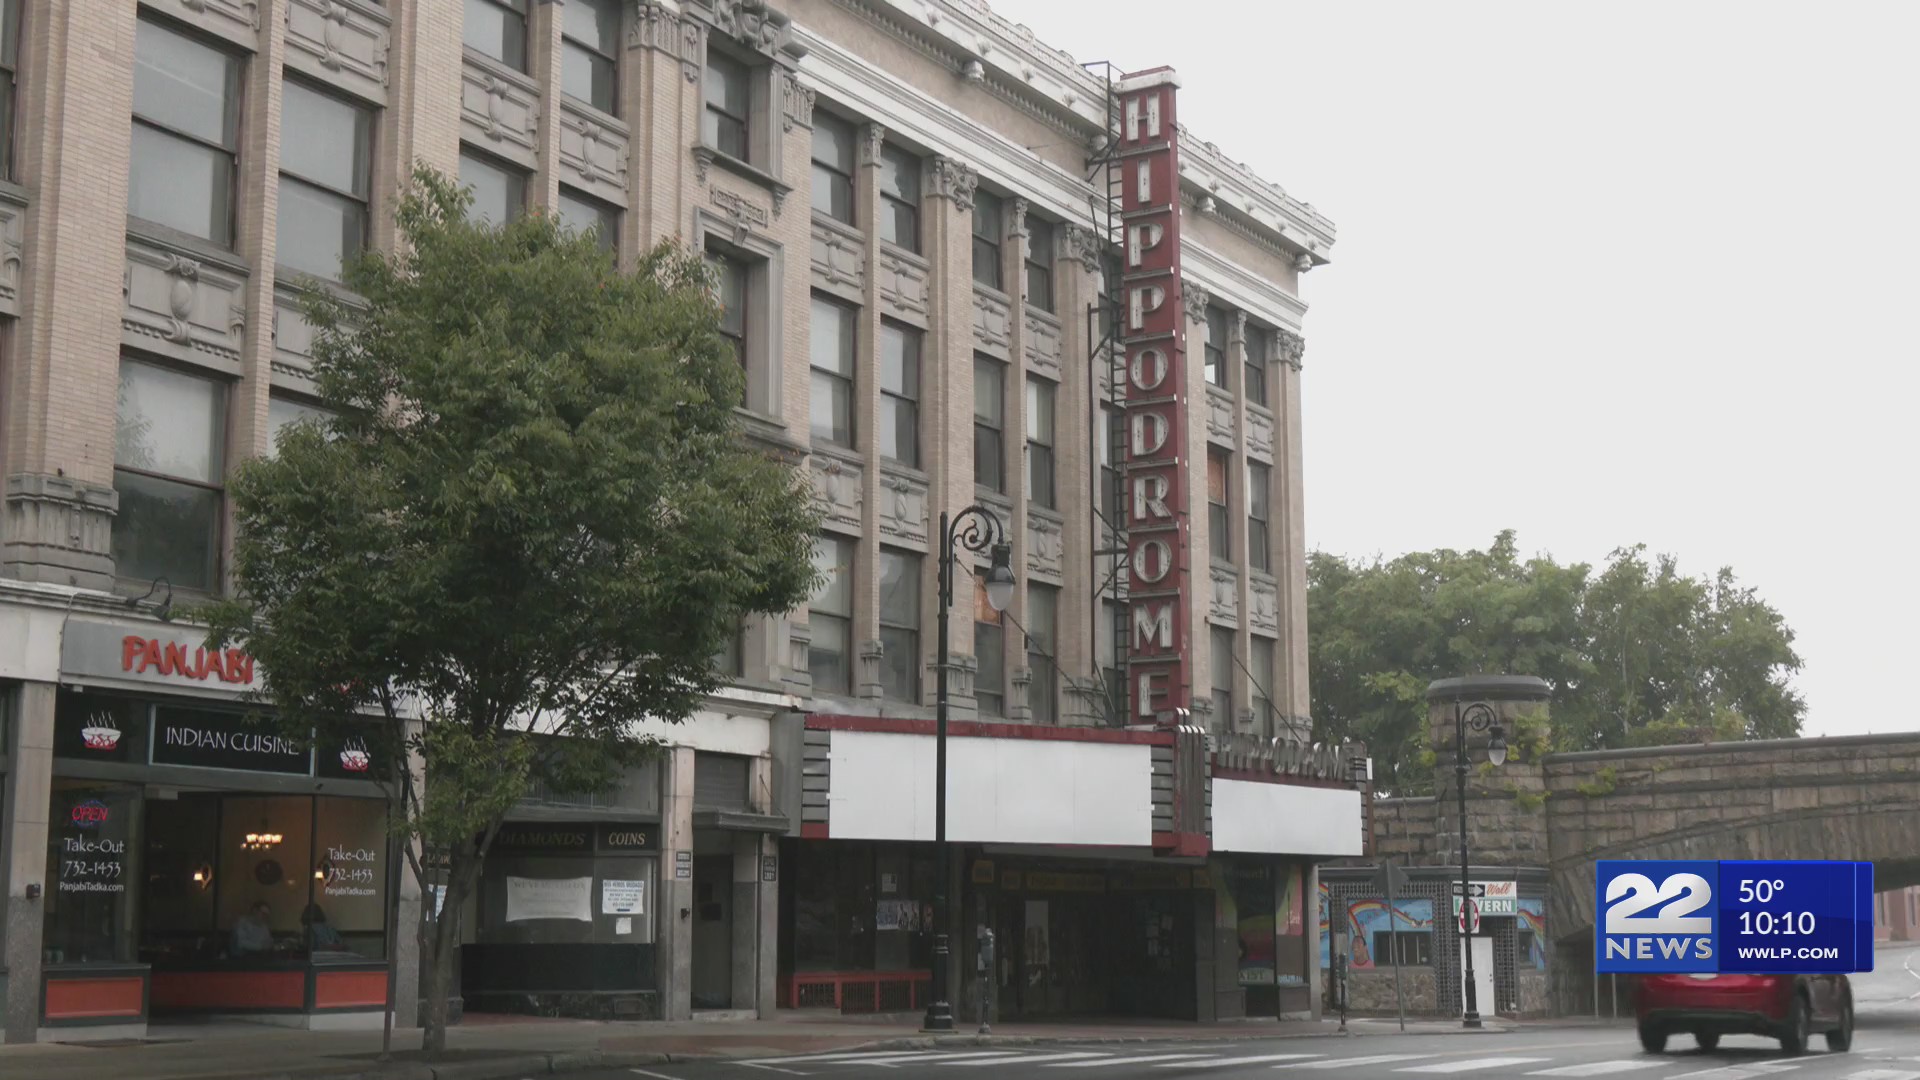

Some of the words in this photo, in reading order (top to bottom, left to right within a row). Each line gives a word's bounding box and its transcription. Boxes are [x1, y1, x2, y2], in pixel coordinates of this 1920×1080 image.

[1126, 92, 1173, 718] HIPPODROME
[122, 635, 254, 685] PANJABI
[166, 726, 227, 750] INDIAN
[230, 732, 300, 756] CUISINE
[71, 807, 109, 821] OPEN
[63, 833, 124, 853] Take-Out
[499, 831, 587, 846] DIAMONDS
[608, 832, 645, 846] COINS
[327, 843, 376, 862] Take-Out
[63, 860, 121, 878] 732-1453
[328, 867, 374, 884] 732-1453
[59, 881, 124, 893] PanjabiTadka.com
[1470, 899, 1512, 912] VERN
